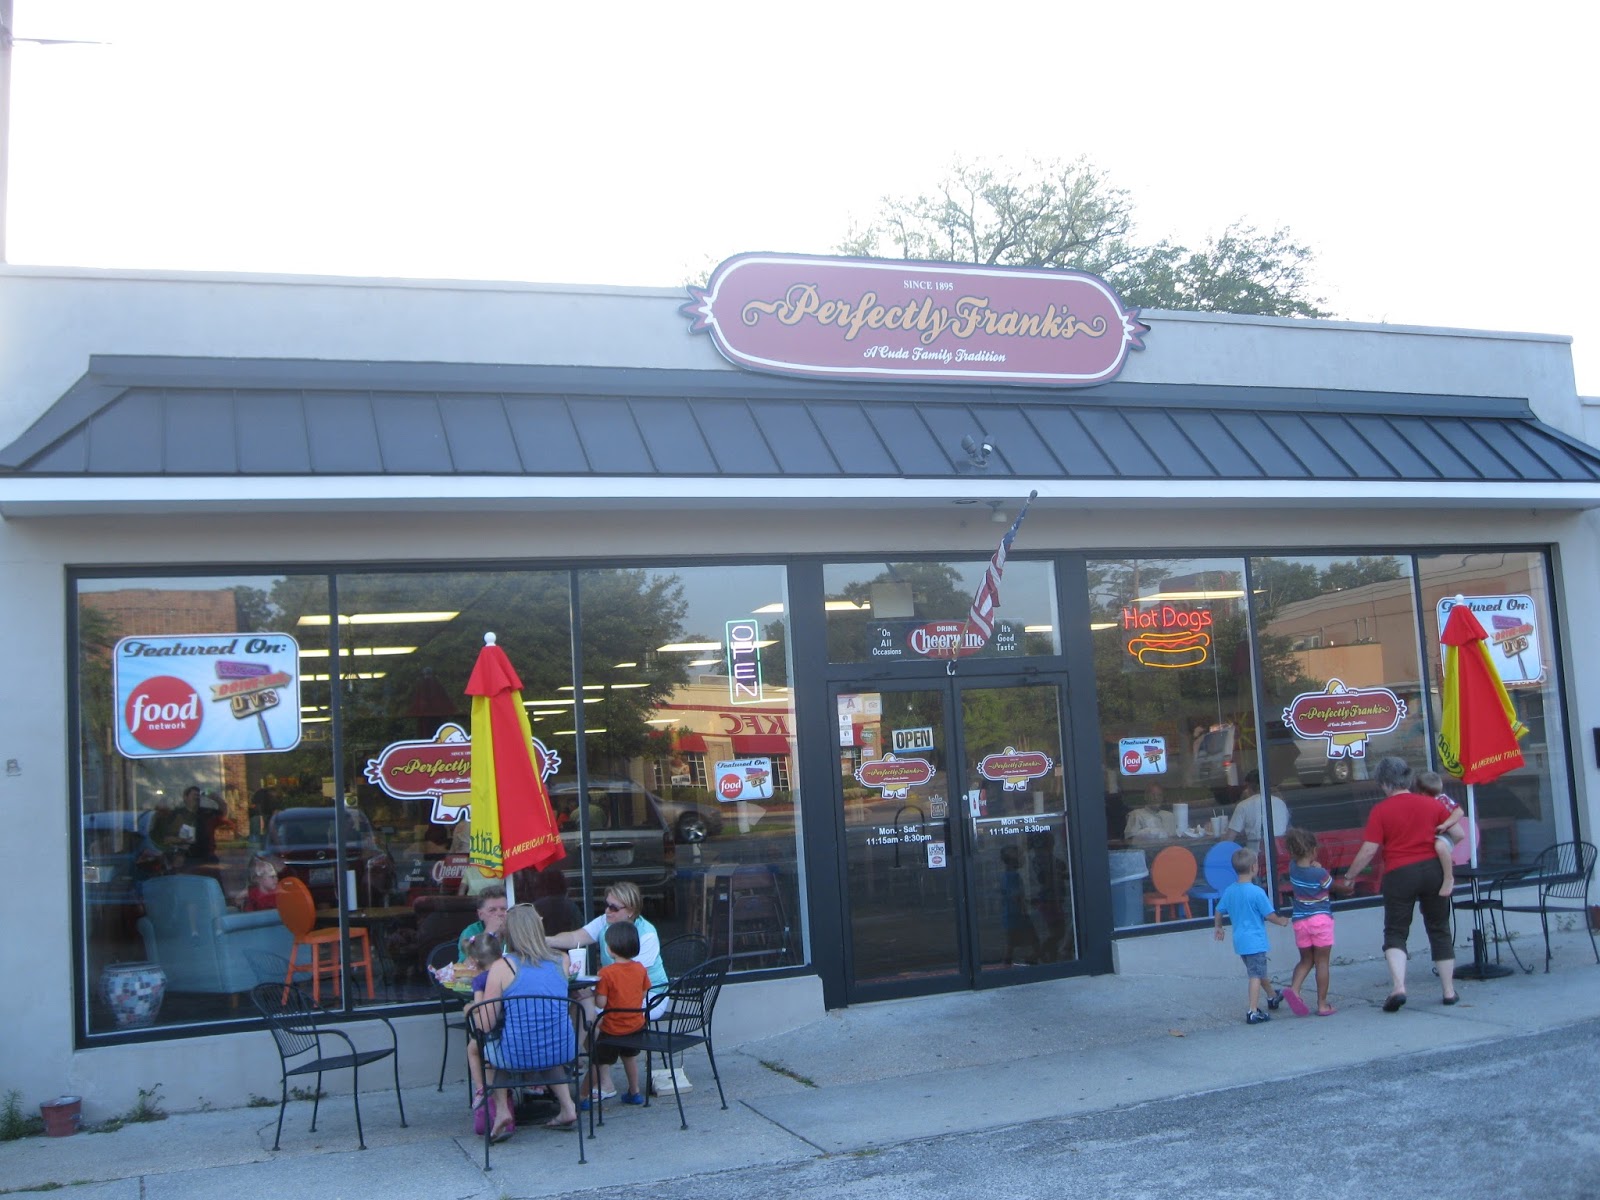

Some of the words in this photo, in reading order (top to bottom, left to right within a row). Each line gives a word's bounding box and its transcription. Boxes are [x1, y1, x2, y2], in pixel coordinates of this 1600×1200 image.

[903, 280, 933, 290] SINCE
[935, 281, 954, 291] 1895
[743, 284, 949, 345] Perfectly
[951, 295, 1107, 339] Frank's
[863, 345, 878, 358] A
[878, 345, 909, 359] Cuda
[911, 347, 953, 364] Family
[955, 348, 1006, 363] Tradition
[1441, 599, 1502, 614] Ftured
[1506, 598, 1528, 611] On:
[1123, 607, 1158, 630] Hot
[1162, 606, 1213, 632] Dogs
[1001, 624, 1011, 633] It's
[880, 639, 892, 648] All
[997, 633, 1015, 643] Good
[123, 638, 239, 658] Featured
[244, 638, 287, 654] On:
[872, 647, 902, 656] Occasions
[731, 625, 758, 698] OPEN
[131, 693, 199, 733] food
[1299, 705, 1349, 722] Perfectly
[1349, 703, 1390, 717] Frank's
[148, 723, 187, 731] network
[895, 729, 931, 749] OPEN
[391, 758, 471, 777] Perfectly
[1124, 755, 1141, 768] food
[721, 779, 741, 794] food
[879, 827, 898, 836] Mon.
[903, 825, 918, 833] Sat.
[1024, 824, 1051, 834] 8:30pm
[512, 836, 546, 857] AMERICAN
[866, 836, 899, 846] 11:15am
[904, 834, 932, 843] 8:30pm
